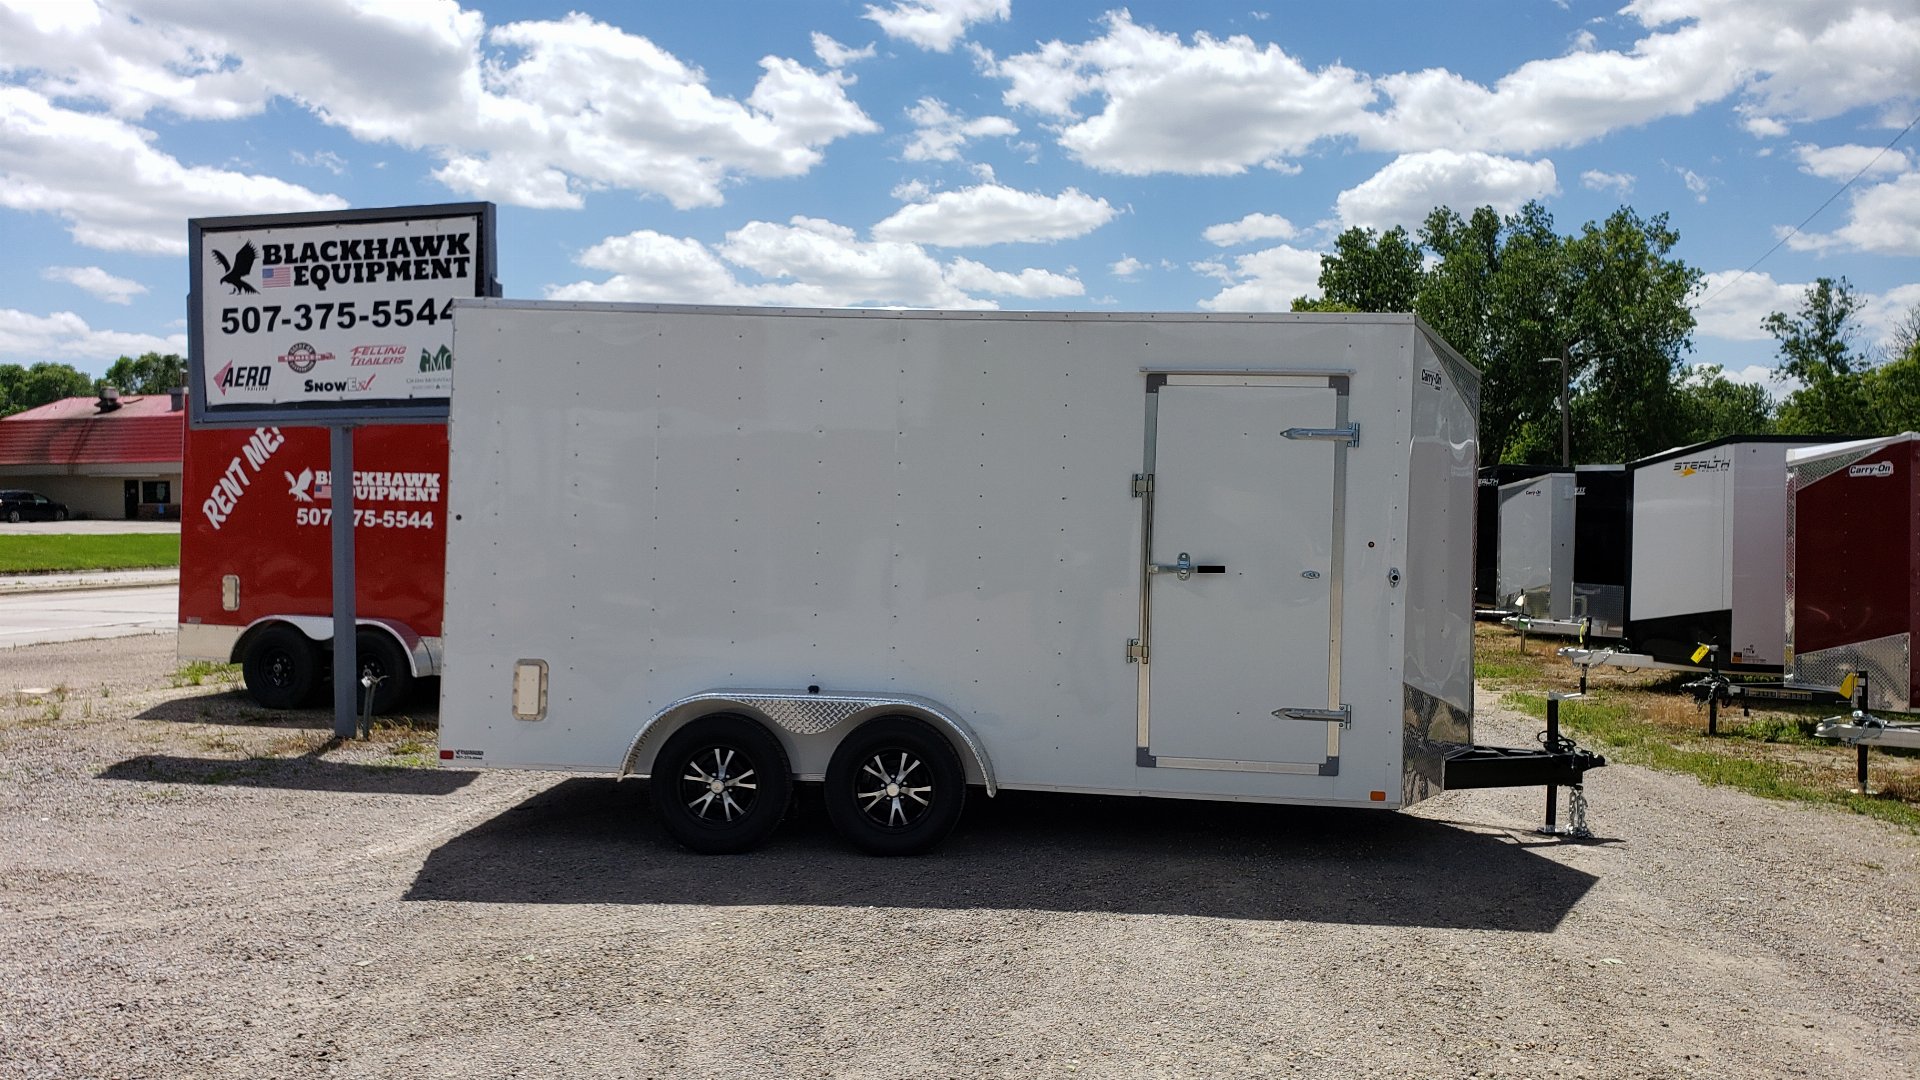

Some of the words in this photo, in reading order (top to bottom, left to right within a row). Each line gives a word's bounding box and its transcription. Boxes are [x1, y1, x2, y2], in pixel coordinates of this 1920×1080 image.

[262, 233, 470, 265] BLACKHAWK
[293, 257, 470, 290] EQUIPMENT
[350, 345, 407, 355] FELLING
[351, 356, 405, 366] TRAILERS
[221, 366, 272, 387] AERO
[1673, 459, 1731, 471] STEALTH
[1850, 464, 1891, 474] Carry-On
[315, 470, 441, 487] BCKHAWK
[202, 456, 251, 530] RENT
[353, 485, 440, 502] UIPMENT
[296, 507, 434, 529] 50775-5544
